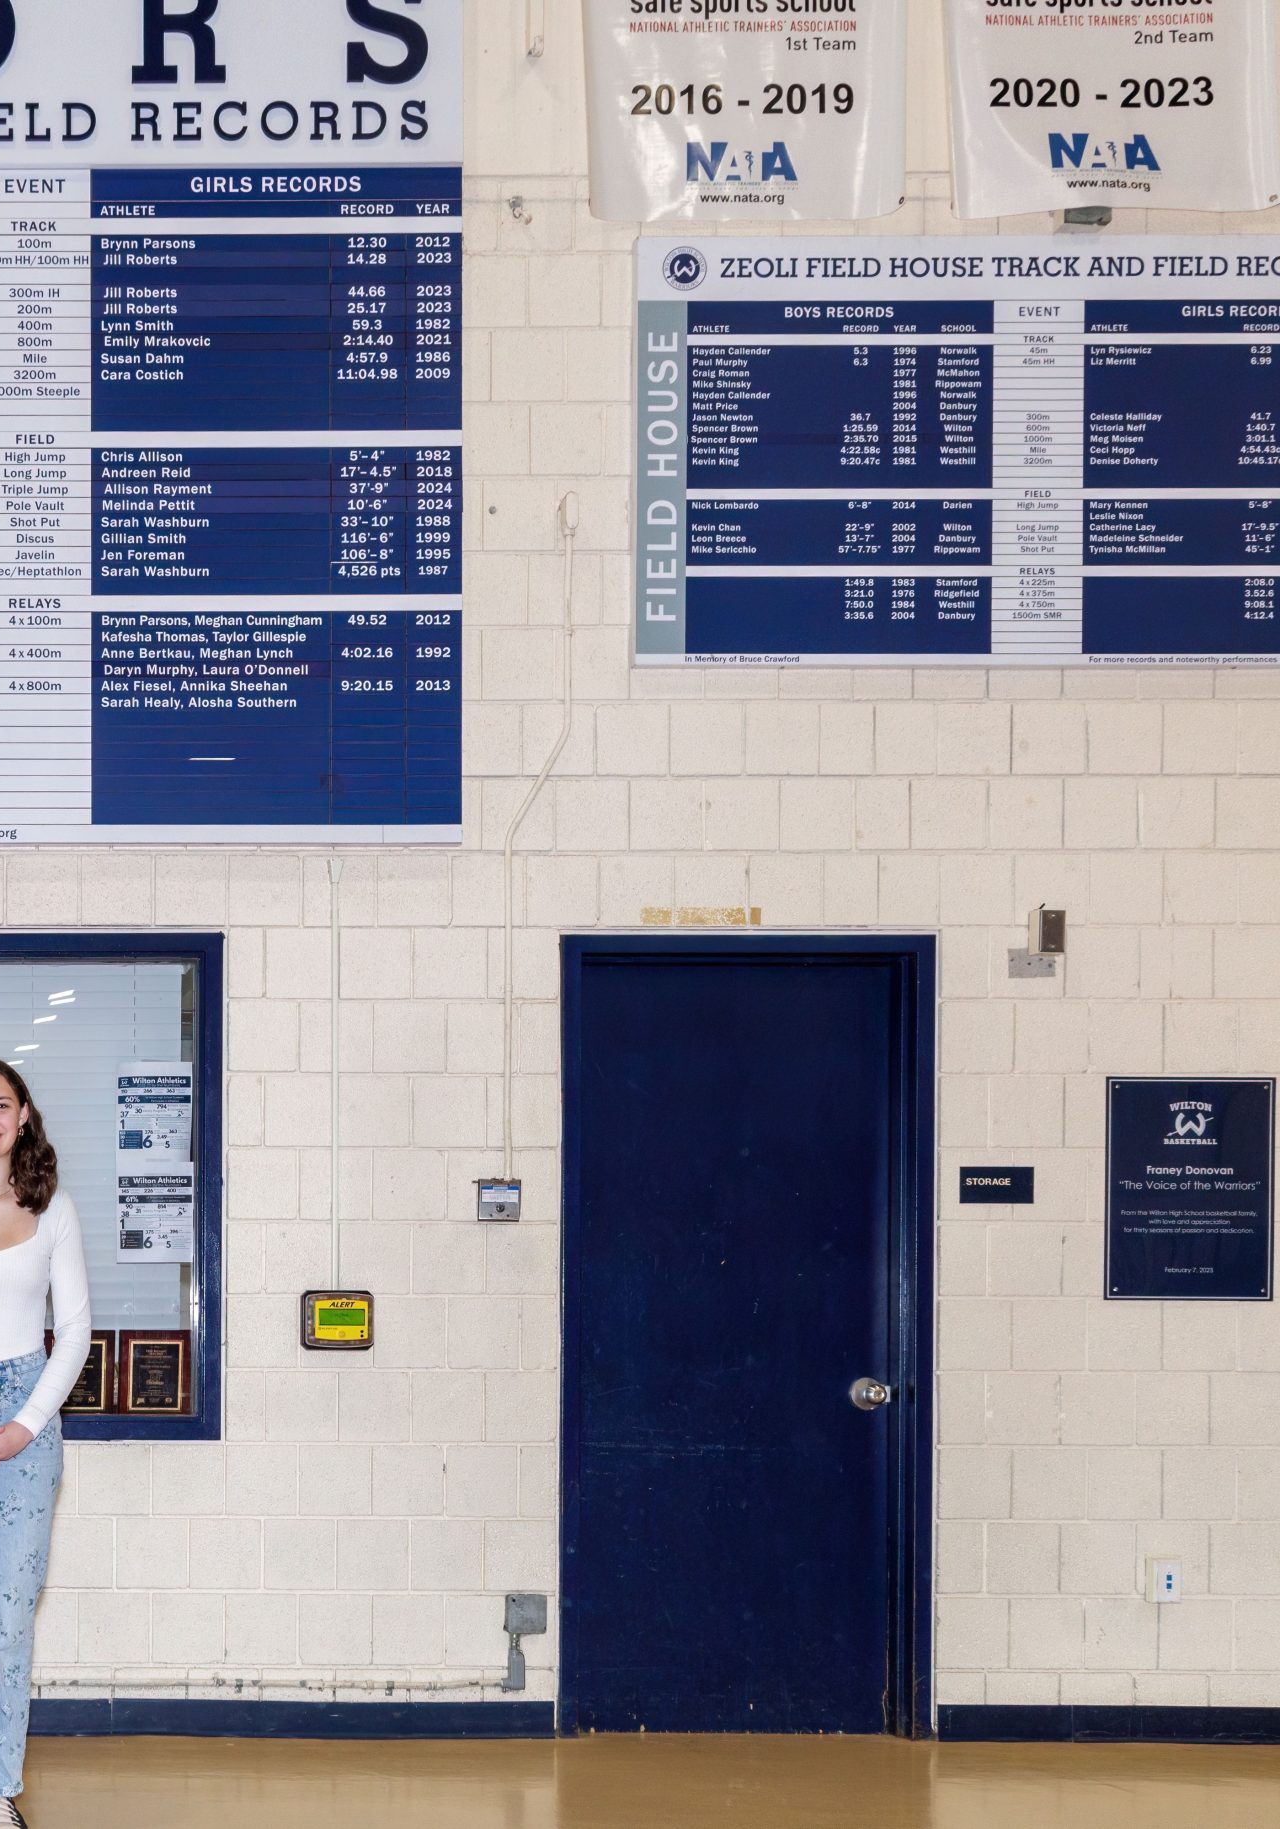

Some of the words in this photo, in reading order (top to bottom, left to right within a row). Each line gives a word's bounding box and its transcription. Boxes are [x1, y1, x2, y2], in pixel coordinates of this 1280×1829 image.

[1134, 30, 1163, 44] 2nd
[1169, 30, 1213, 43] Team
[786, 37, 807, 51] 1st
[813, 37, 856, 50] Team
[990, 78, 1080, 108] 2020
[1120, 76, 1214, 108] 2023
[631, 84, 722, 115] 2016
[762, 83, 854, 114] 2019
[131, 100, 428, 141] RECORDS
[5, 179, 66, 193] EVENT
[191, 176, 252, 193] GIRLS
[262, 176, 361, 192] RECORDS
[1067, 179, 1151, 192] www.nata.org
[700, 193, 784, 205] www.nata.org
[100, 205, 155, 216] ATHLETE
[18, 239, 52, 248] 100m
[101, 238, 138, 251] Brynn
[143, 238, 196, 249] Parsons
[348, 237, 387, 248] 12.30
[720, 258, 798, 278] ZEOLI
[806, 257, 881, 278] FIELD
[889, 257, 983, 278] HOUSE
[992, 256, 1080, 277] TRACK
[1087, 256, 1145, 277] AND
[1152, 256, 1228, 276] FIELD
[785, 306, 821, 318] BOYS
[826, 306, 894, 318] RECORDS
[1019, 306, 1060, 317] EVENT
[1182, 305, 1224, 317] GIRLS
[1230, 305, 1280, 317] RECOR
[692, 325, 730, 333] ATHLETE
[941, 324, 977, 333] SCHOOL
[104, 336, 139, 349] Emily
[144, 336, 210, 347] Mrakovcic
[693, 347, 725, 356] Hayden
[728, 347, 771, 355] Callender
[940, 347, 977, 355] Norwalk
[1091, 346, 1106, 356] Lyn
[1108, 346, 1152, 356] Rysiewicz
[36, 386, 80, 398] Steeple
[646, 332, 677, 477] HOUSE
[943, 501, 972, 509] Darien
[1089, 534, 1136, 542] Madeleine
[1138, 534, 1184, 542] Schneider
[646, 500, 677, 621] FIELD
[934, 589, 979, 599] Ridgefield
[9, 598, 61, 609] RELAYS
[1169, 1101, 1212, 1112] WILTON
[1146, 1165, 1183, 1176] Franey
[1185, 1165, 1234, 1175] Donovan
[131, 1176, 156, 1184] Wilton
[966, 1178, 1011, 1186] STORAGE
[1119, 1180, 1143, 1190] "The
[1145, 1180, 1177, 1190] Voice
[1180, 1180, 1191, 1190] of
[1194, 1180, 1211, 1190] the
[1214, 1181, 1260, 1190] Warriors"
